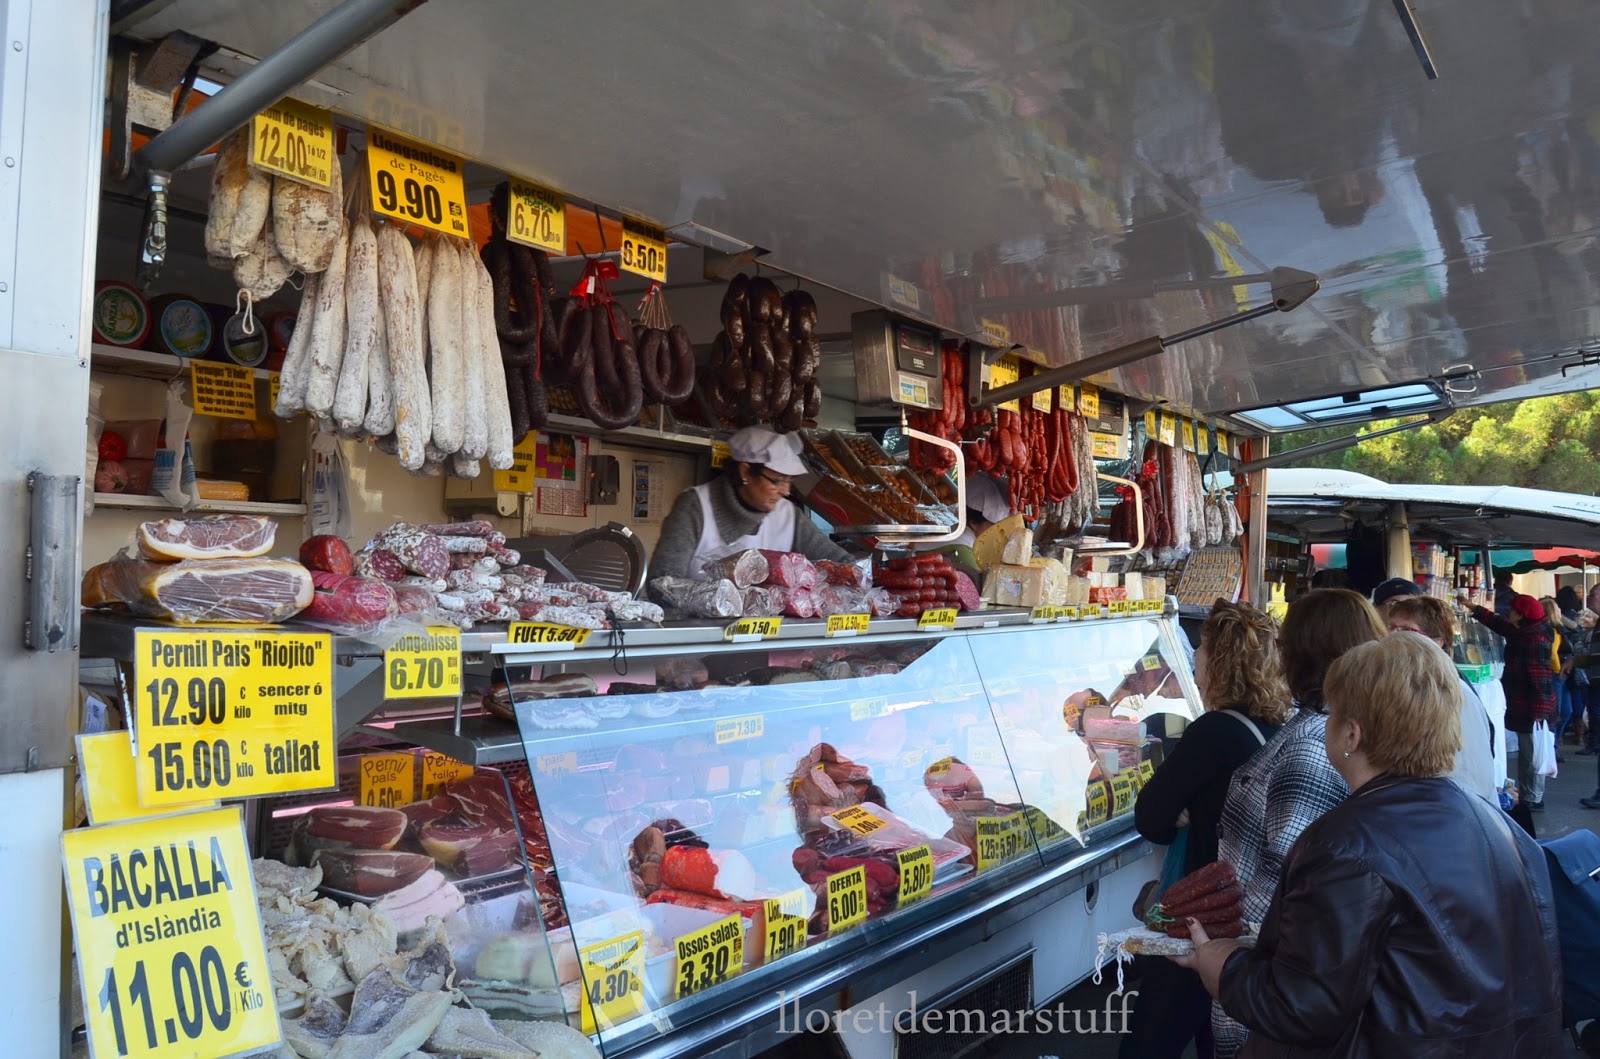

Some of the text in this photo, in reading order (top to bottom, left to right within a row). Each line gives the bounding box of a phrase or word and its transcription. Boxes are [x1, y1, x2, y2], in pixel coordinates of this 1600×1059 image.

[283, 112, 295, 127] de
[297, 117, 325, 138] pagès
[260, 123, 307, 176] 12.00
[372, 132, 457, 174] Llonganissa
[390, 157, 446, 184] de Pagès
[377, 169, 443, 225] 9.90
[514, 202, 551, 243] 6.70
[623, 239, 657, 274] 6.50
[514, 626, 578, 644] FUET 5.50
[751, 621, 770, 635] 7.50
[828, 616, 844, 632] OFERTA
[151, 639, 208, 668] Pernil
[212, 639, 250, 668] Pais
[258, 684, 310, 697] sencer
[390, 657, 444, 690] 6.70
[146, 676, 226, 727] 12.90
[234, 705, 251, 719] kilo
[274, 702, 308, 716] mitg
[737, 719, 756, 737] 7.30
[148, 738, 231, 792] 15.00
[236, 762, 254, 778] kilo
[264, 739, 321, 775] tallat
[363, 758, 407, 777] Pernil
[432, 768, 460, 780] tallat
[83, 836, 233, 918] BACALLA
[830, 871, 863, 894] OFERTA
[903, 863, 926, 897] 5.80
[830, 889, 858, 925] 6.00
[116, 907, 222, 949] d'Islàndia
[678, 921, 740, 960] Ossos salats
[769, 923, 795, 956] 7.90
[680, 945, 729, 992] 3.30
[98, 945, 253, 1057] 11.00 €
[590, 969, 629, 1006] 4.30
